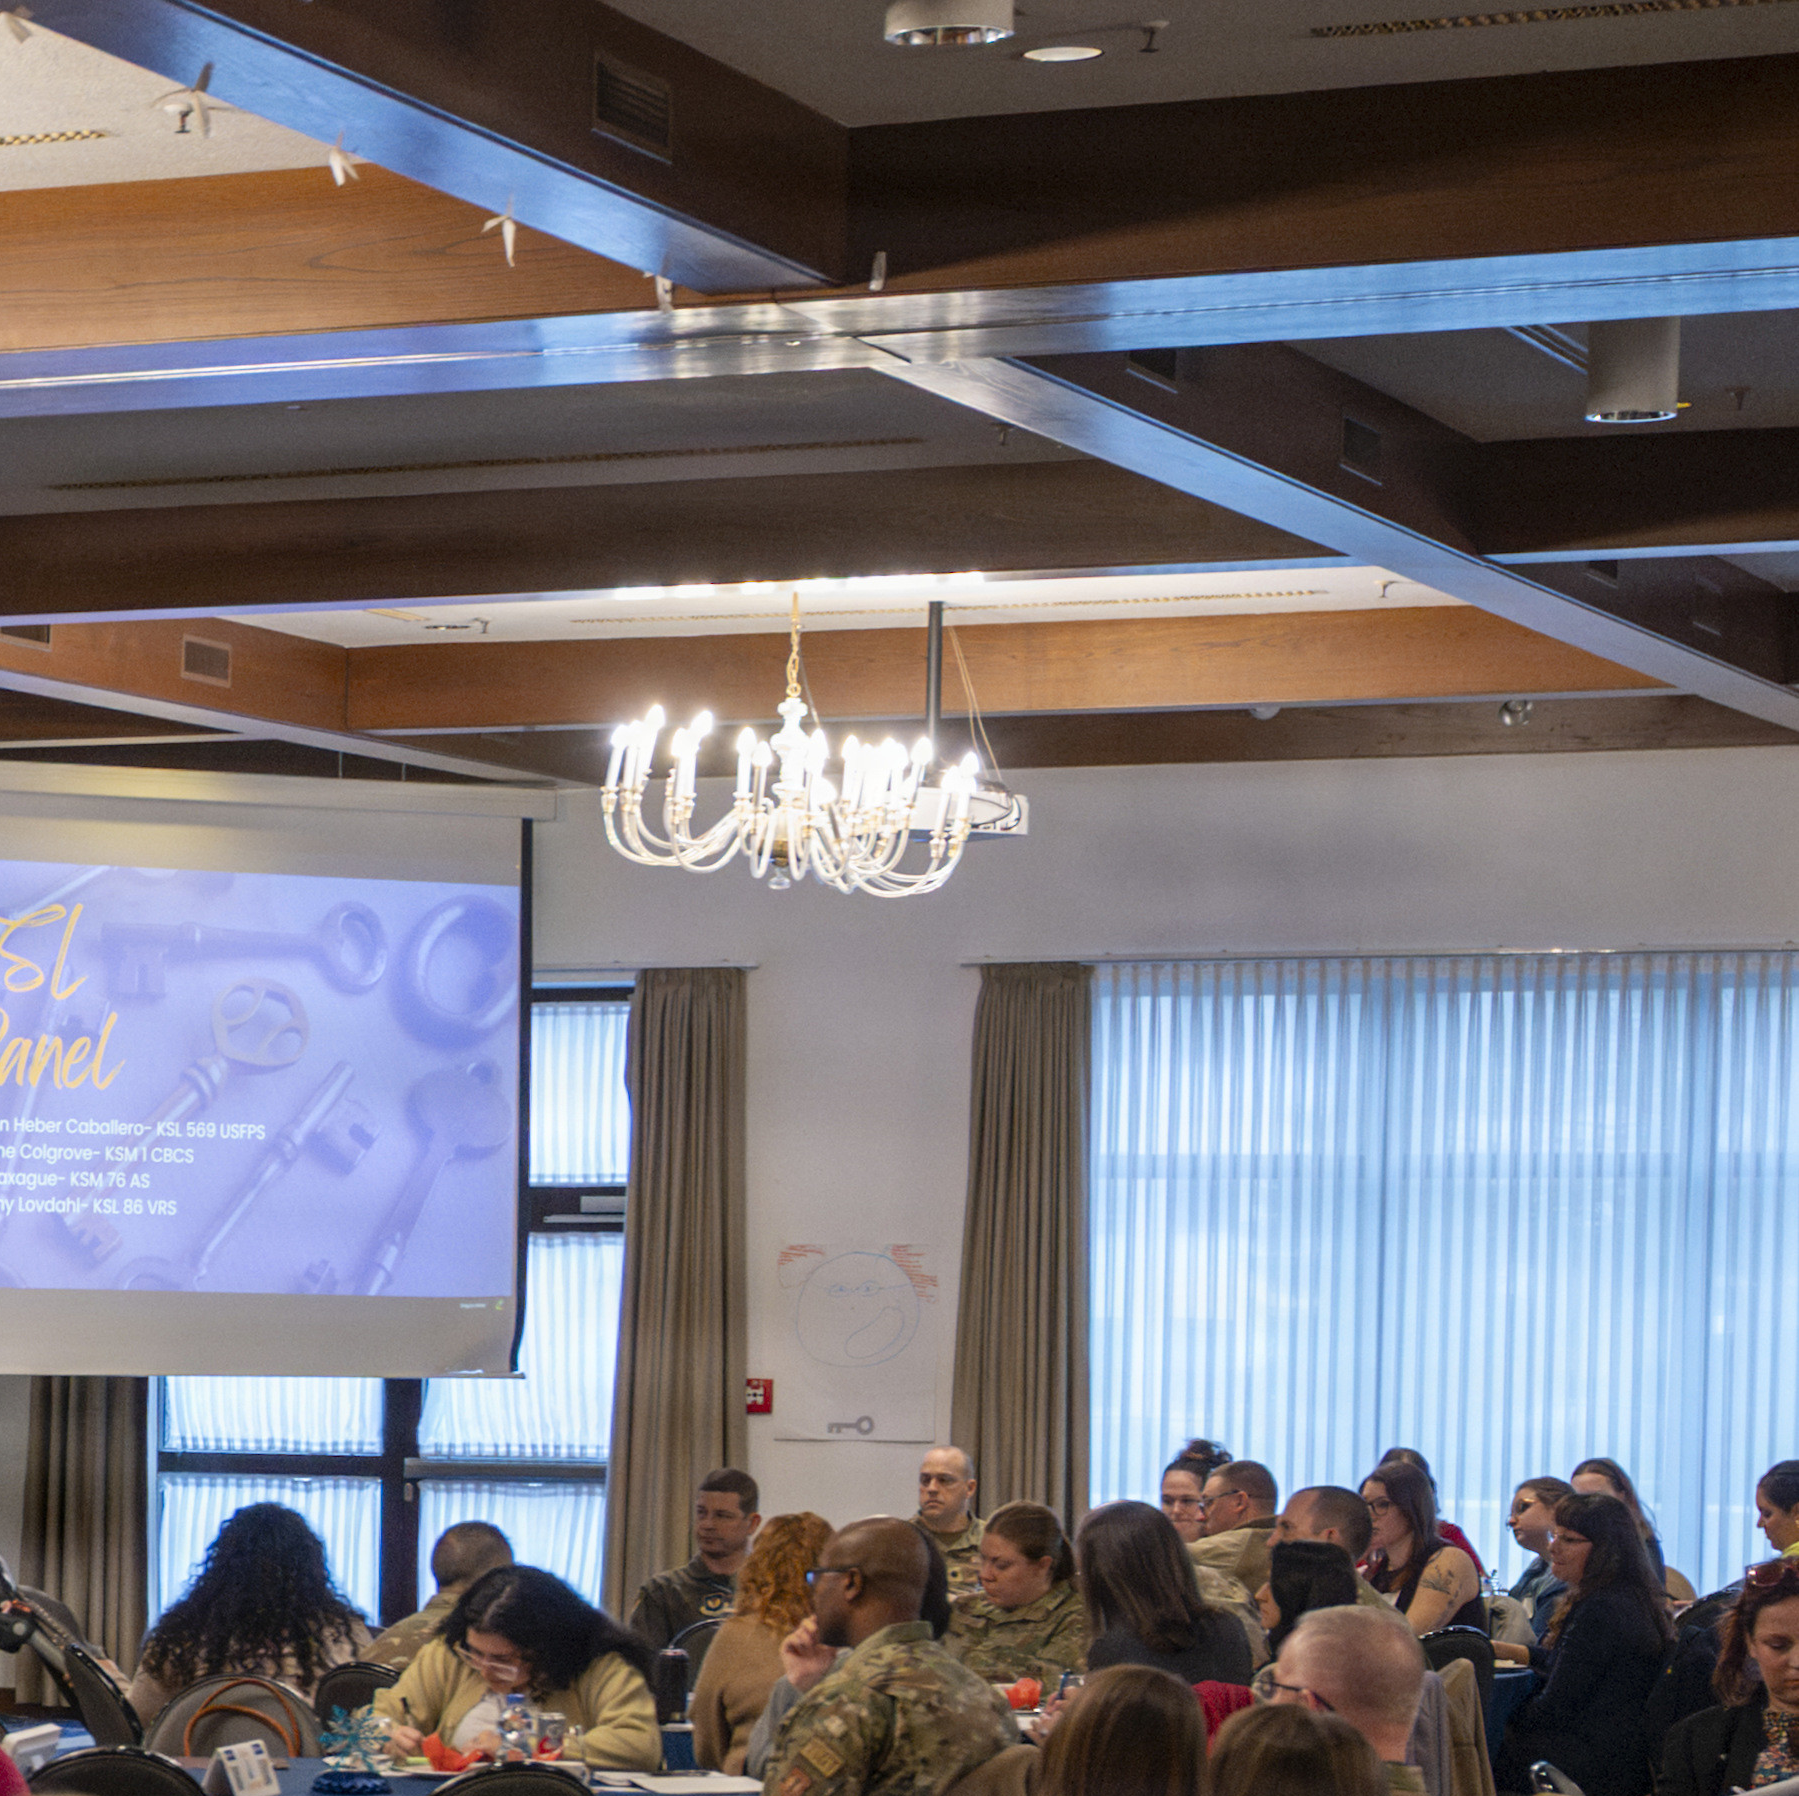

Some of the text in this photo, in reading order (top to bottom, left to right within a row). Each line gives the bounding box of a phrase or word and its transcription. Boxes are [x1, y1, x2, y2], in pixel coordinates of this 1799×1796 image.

[13, 1117, 62, 1133] Heber
[65, 1118, 152, 1136] Caballero-
[156, 1121, 182, 1137] KSL
[186, 1121, 216, 1138] 569
[220, 1123, 266, 1140] USFPS
[19, 1143, 101, 1164] Colgrove-
[105, 1146, 138, 1161] KSM
[150, 1147, 195, 1163] CBCS
[70, 1171, 104, 1187] KSM
[107, 1172, 127, 1187] 76
[130, 1173, 151, 1188] AS
[18, 1197, 89, 1213] Lovdahl-
[93, 1198, 120, 1214] KSL
[123, 1199, 144, 1215] 86
[147, 1200, 178, 1216] VRS
